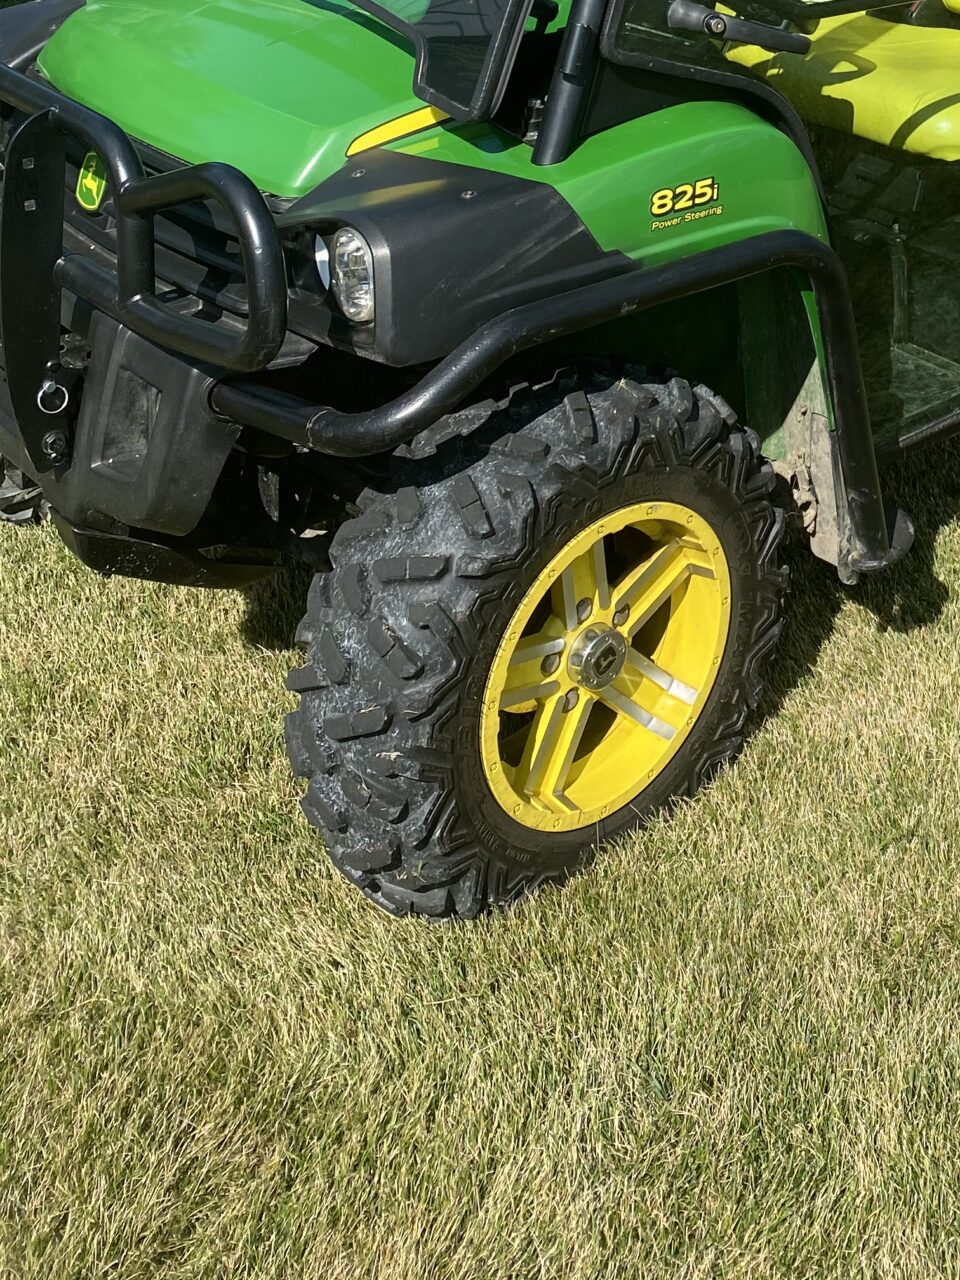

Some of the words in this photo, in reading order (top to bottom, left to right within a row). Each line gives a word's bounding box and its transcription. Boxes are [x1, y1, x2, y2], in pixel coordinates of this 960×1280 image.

[650, 177, 719, 216] 825i
[651, 217, 682, 231] Power
[684, 206, 724, 222] Steering
